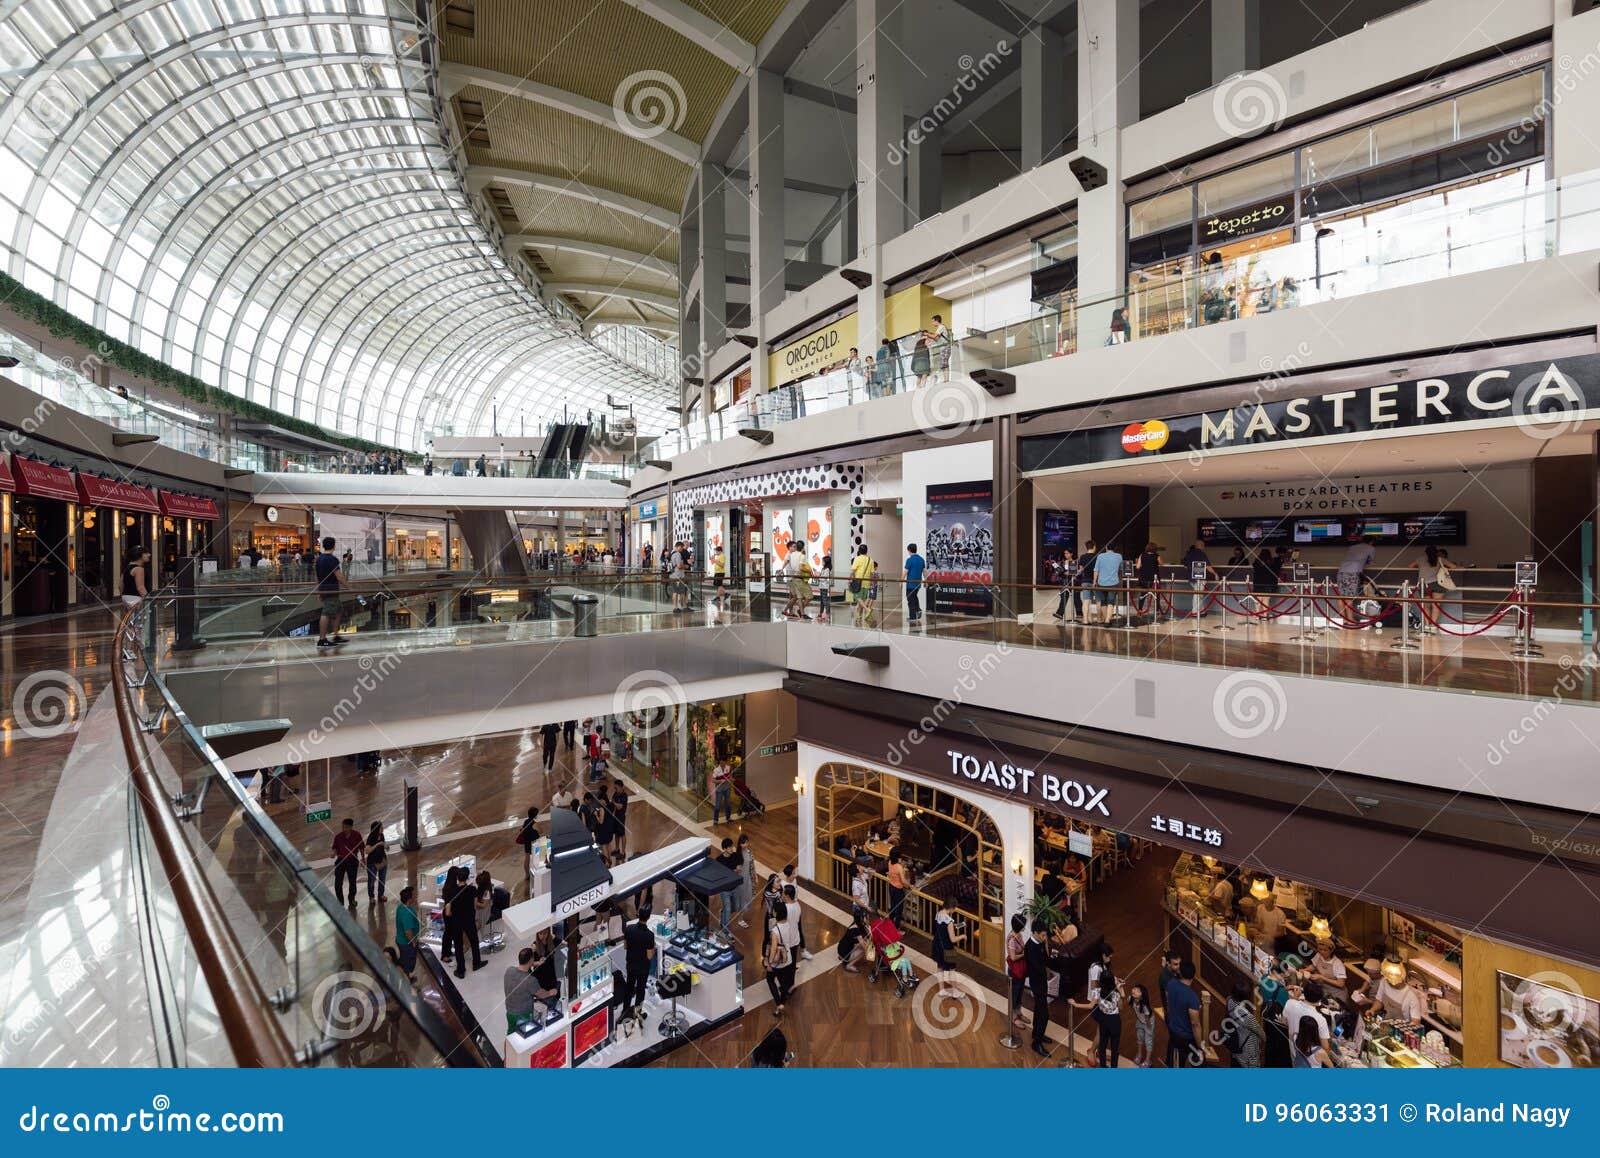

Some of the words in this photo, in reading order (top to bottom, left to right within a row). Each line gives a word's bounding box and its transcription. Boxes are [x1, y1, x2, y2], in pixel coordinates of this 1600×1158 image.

[1207, 205, 1285, 235] repetto
[1121, 430, 1165, 444] MasterCard
[1239, 486, 1339, 499] MASTERCARD
[1345, 481, 1432, 494] THEATRES
[1283, 501, 1313, 511] BOX
[1318, 498, 1377, 510] OFFICE
[947, 750, 1034, 794] TOAST
[1042, 774, 1110, 817] BOX
[1150, 815, 1222, 847] 土司工坊
[562, 886, 604, 914] ONSEN
